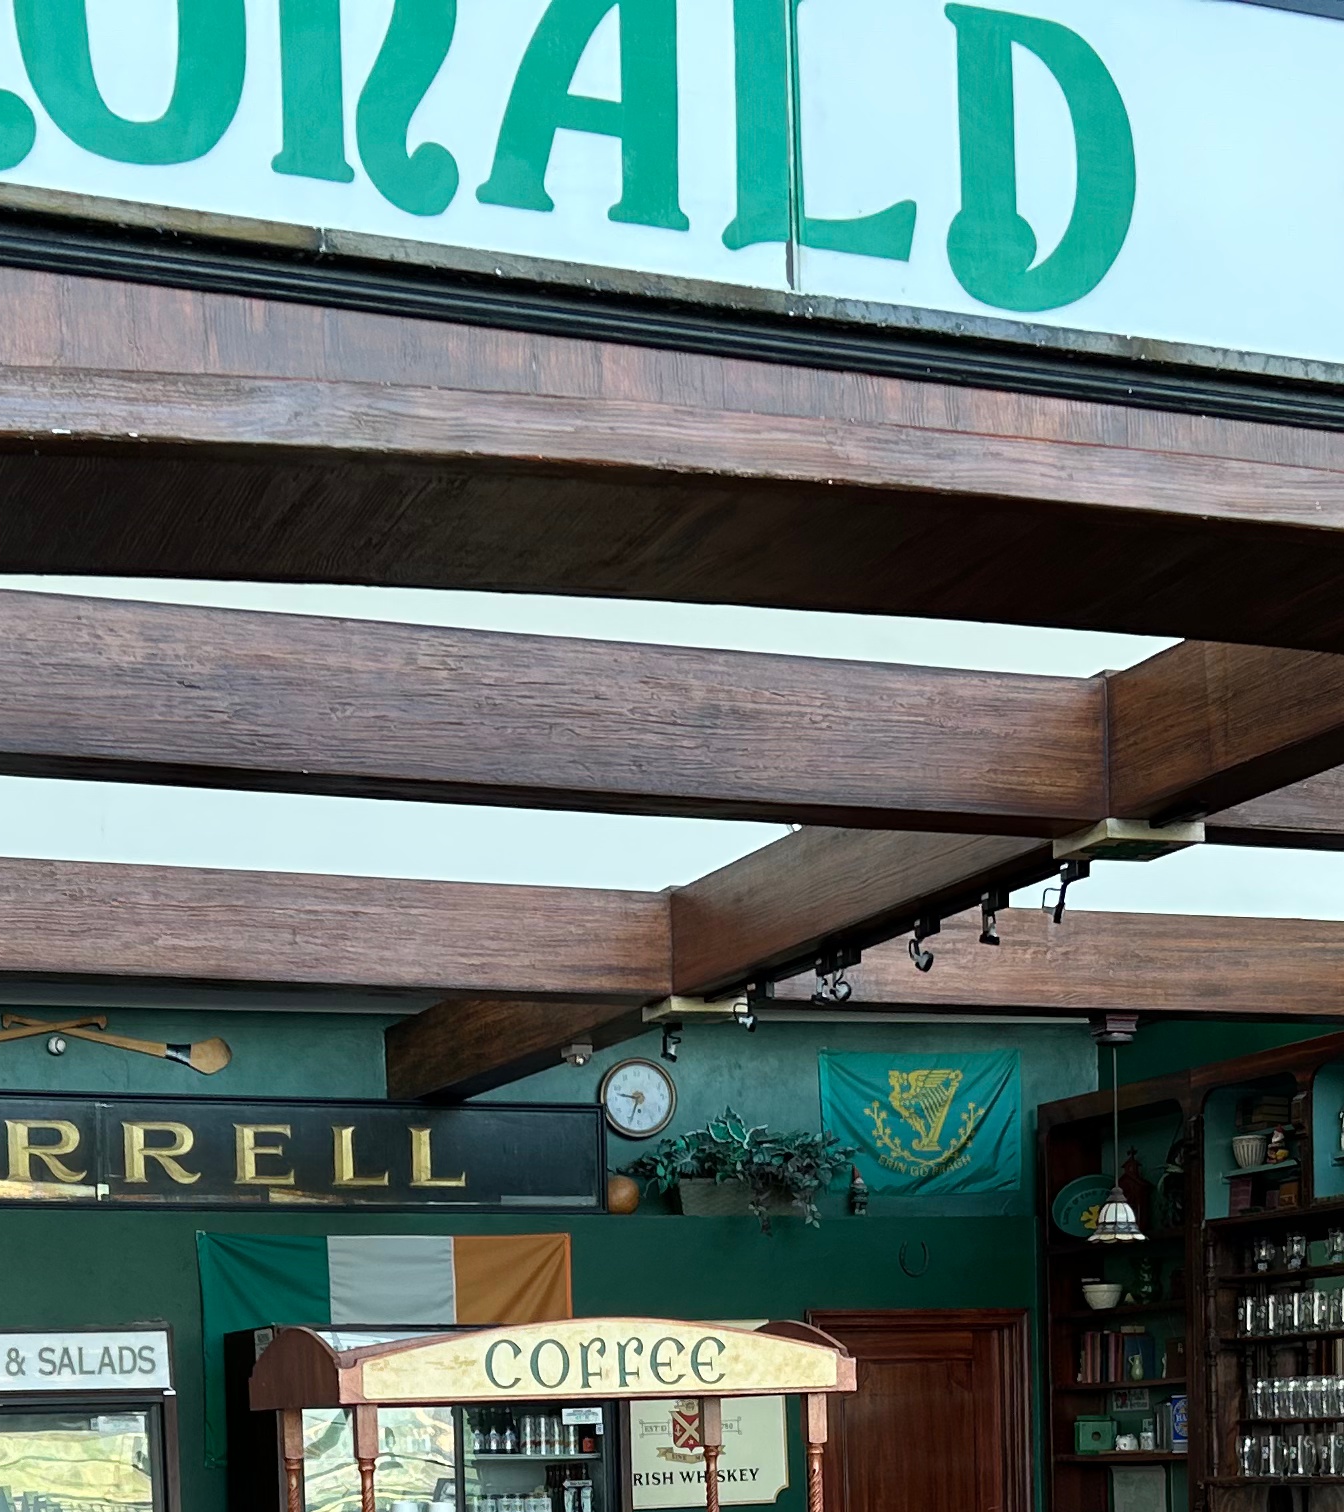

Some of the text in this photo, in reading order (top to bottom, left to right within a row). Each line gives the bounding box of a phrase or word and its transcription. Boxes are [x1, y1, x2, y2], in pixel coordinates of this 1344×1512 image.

[878, 1154, 907, 1174] ERIN
[5, 1347, 26, 1376] &
[37, 1345, 157, 1376] SALADS
[484, 1336, 727, 1389] COFFEE
[633, 1468, 760, 1486] RISH WHSKEY
